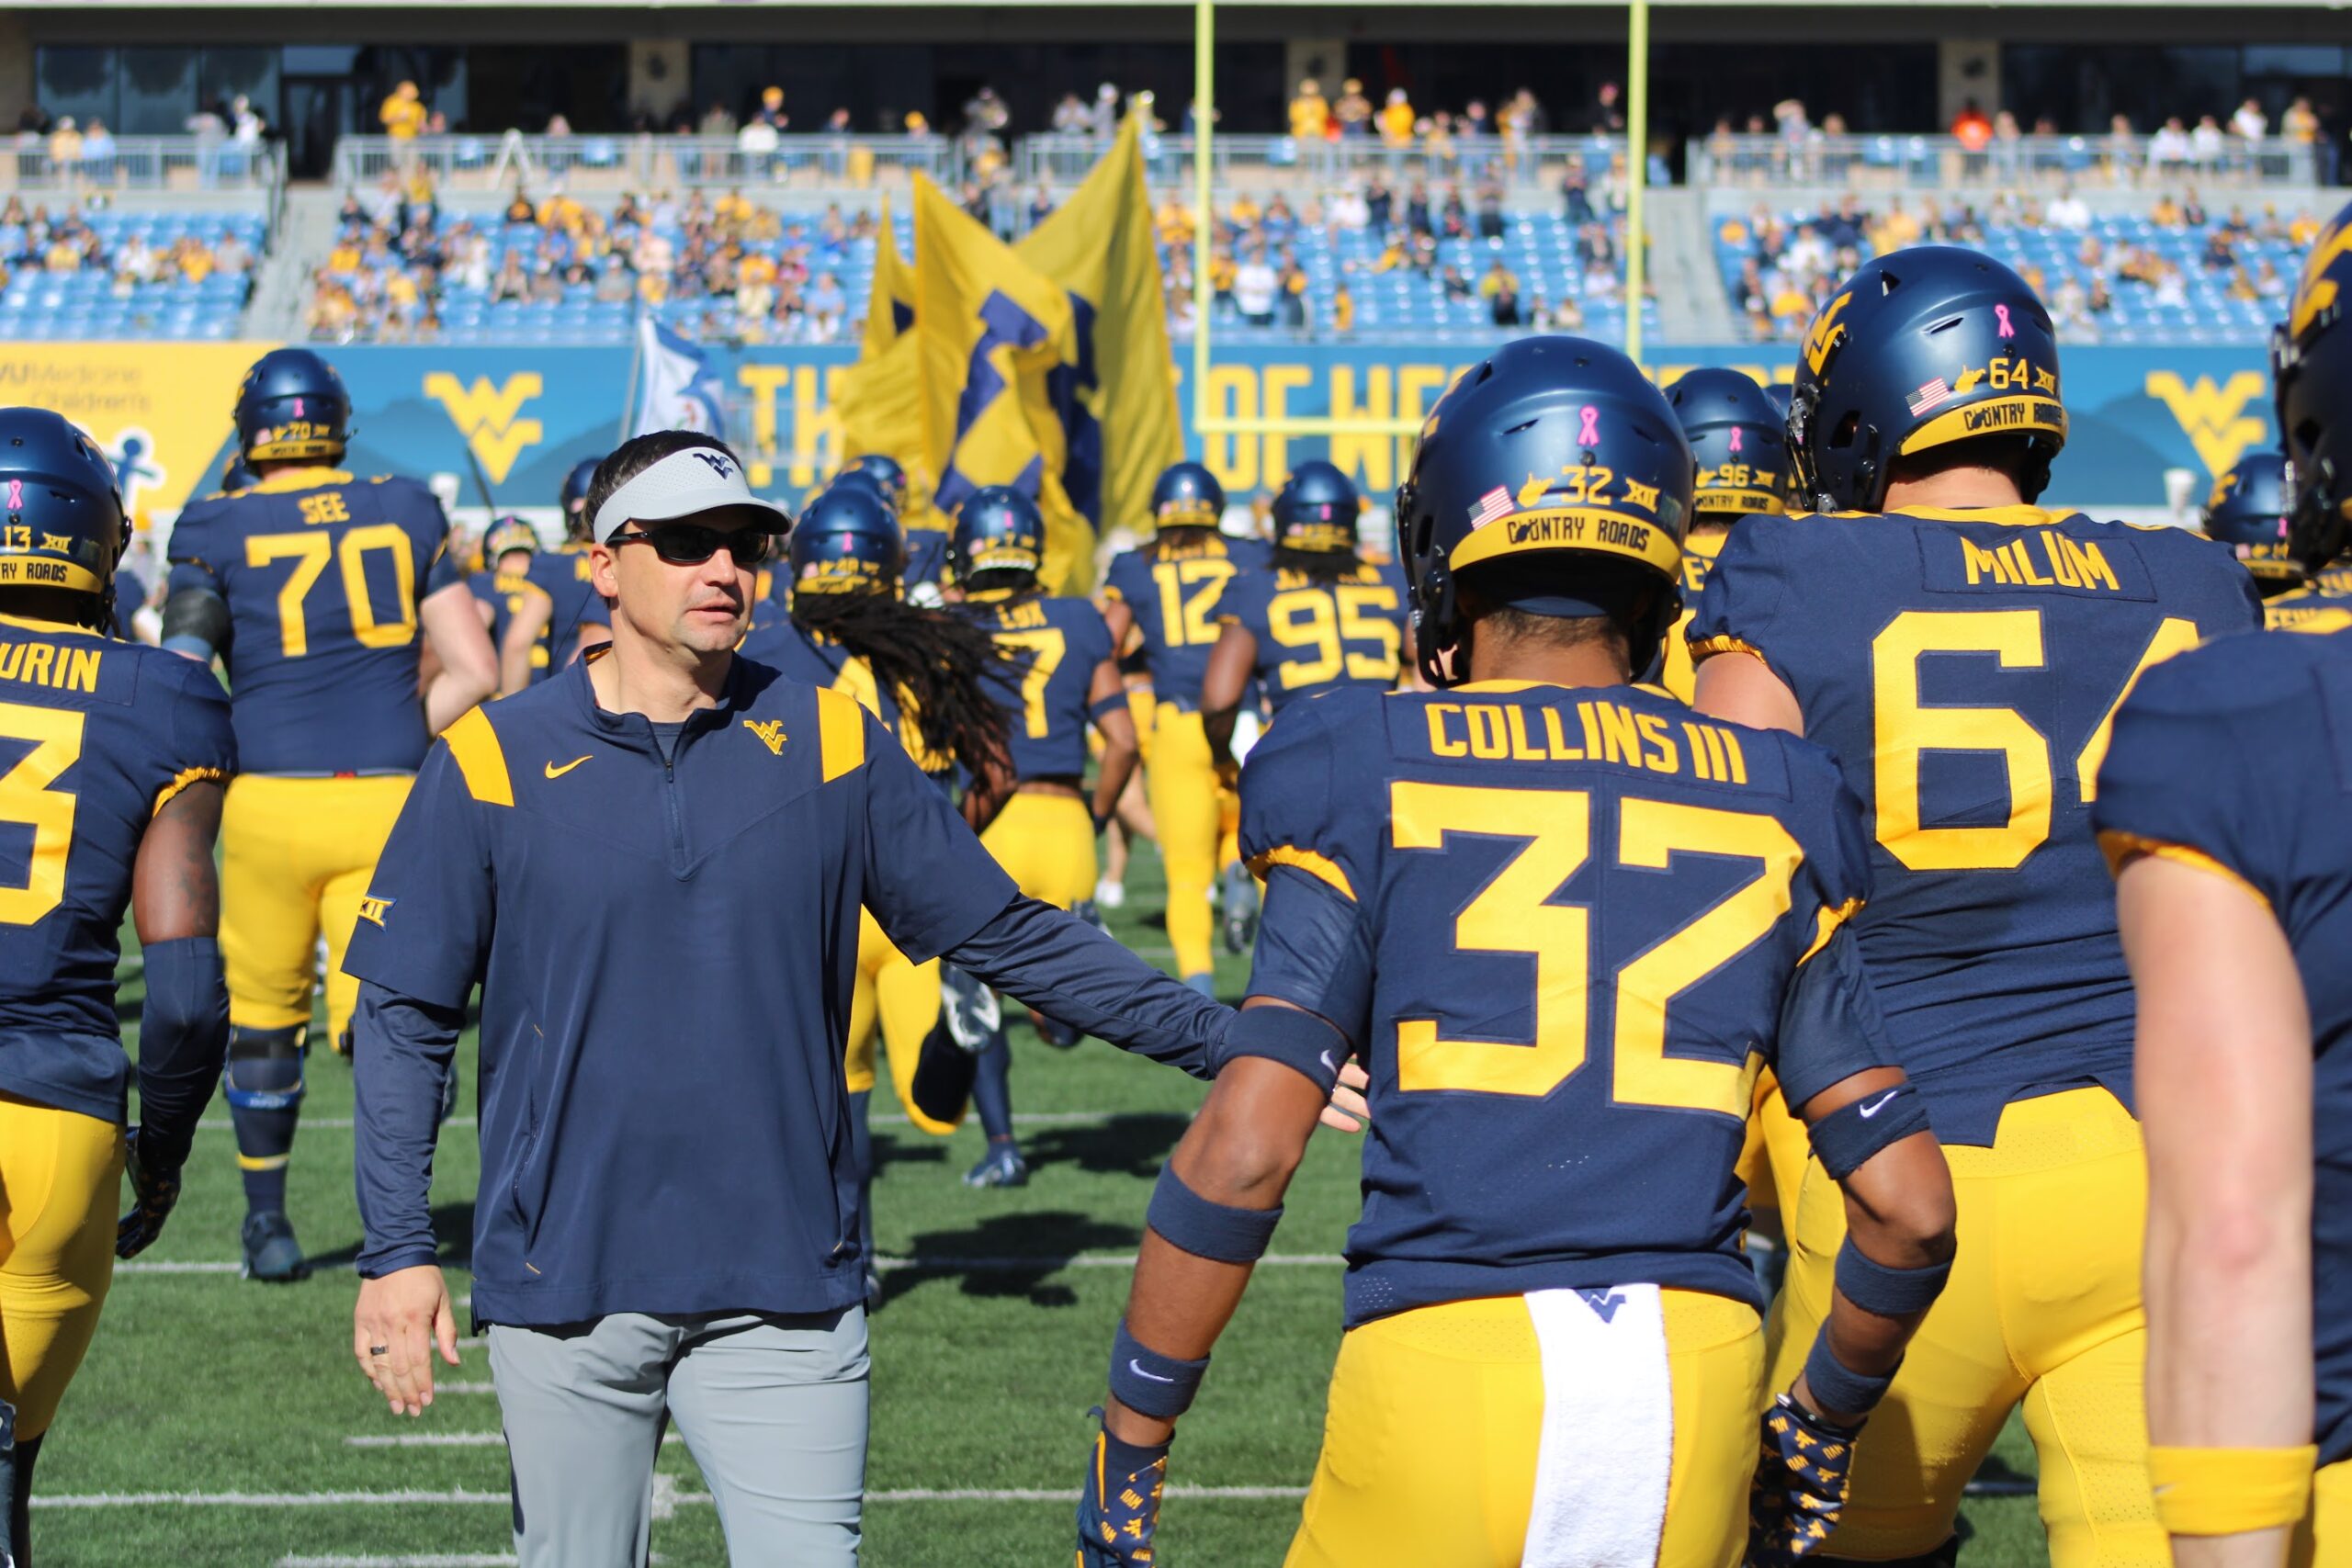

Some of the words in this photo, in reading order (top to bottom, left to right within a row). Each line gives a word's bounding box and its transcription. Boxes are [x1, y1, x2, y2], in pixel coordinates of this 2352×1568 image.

[1989, 357, 2029, 389] 64
[288, 422, 311, 441] 70
[1204, 364, 1312, 492] OF
[1561, 466, 1612, 506] 32
[1719, 463, 1750, 488] 96
[298, 491, 350, 525] SEE
[4, 525, 31, 553] 13
[1597, 518, 1650, 551] ROADS
[27, 562, 68, 582] ROADS
[1961, 531, 2120, 591] MILUM
[245, 523, 418, 658] 70
[1152, 558, 1237, 647] 12
[1267, 584, 1401, 690] 95
[990, 627, 1066, 739] 7
[1426, 701, 1679, 774] COLLINS
[1680, 720, 1747, 785] III
[1391, 781, 1804, 1121] 32
